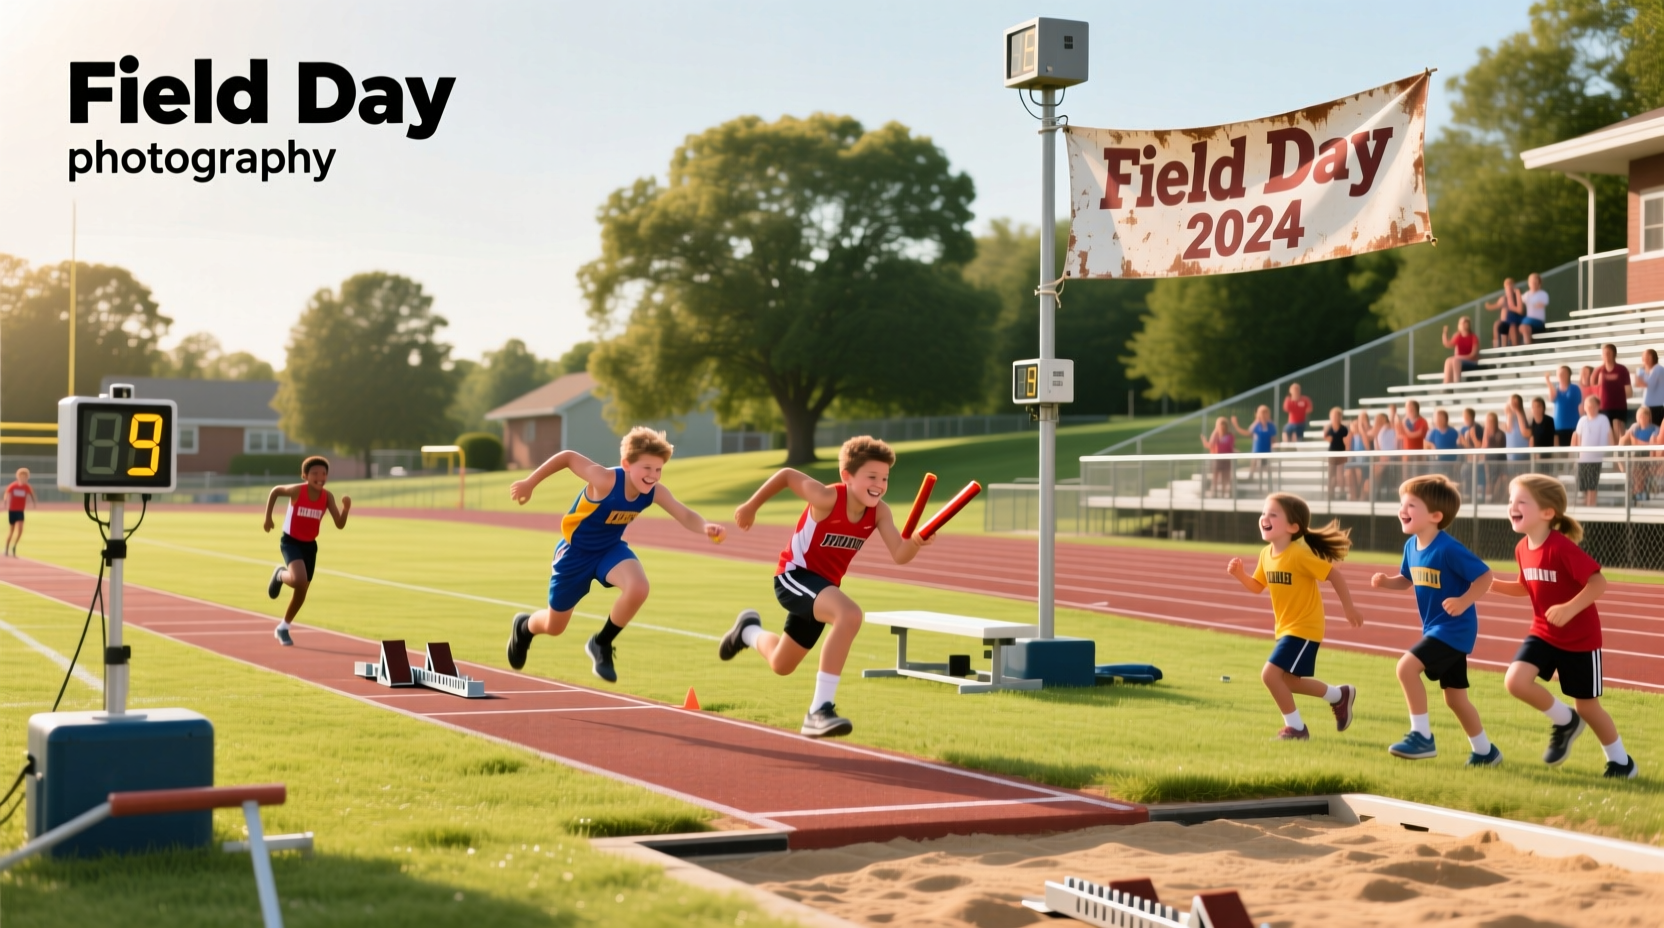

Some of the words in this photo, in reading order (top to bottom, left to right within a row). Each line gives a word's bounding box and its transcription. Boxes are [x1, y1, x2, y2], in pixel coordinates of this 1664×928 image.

[1099, 134, 1247, 210] Field
[1262, 126, 1394, 198] Day
[1182, 198, 1305, 260] 2024
